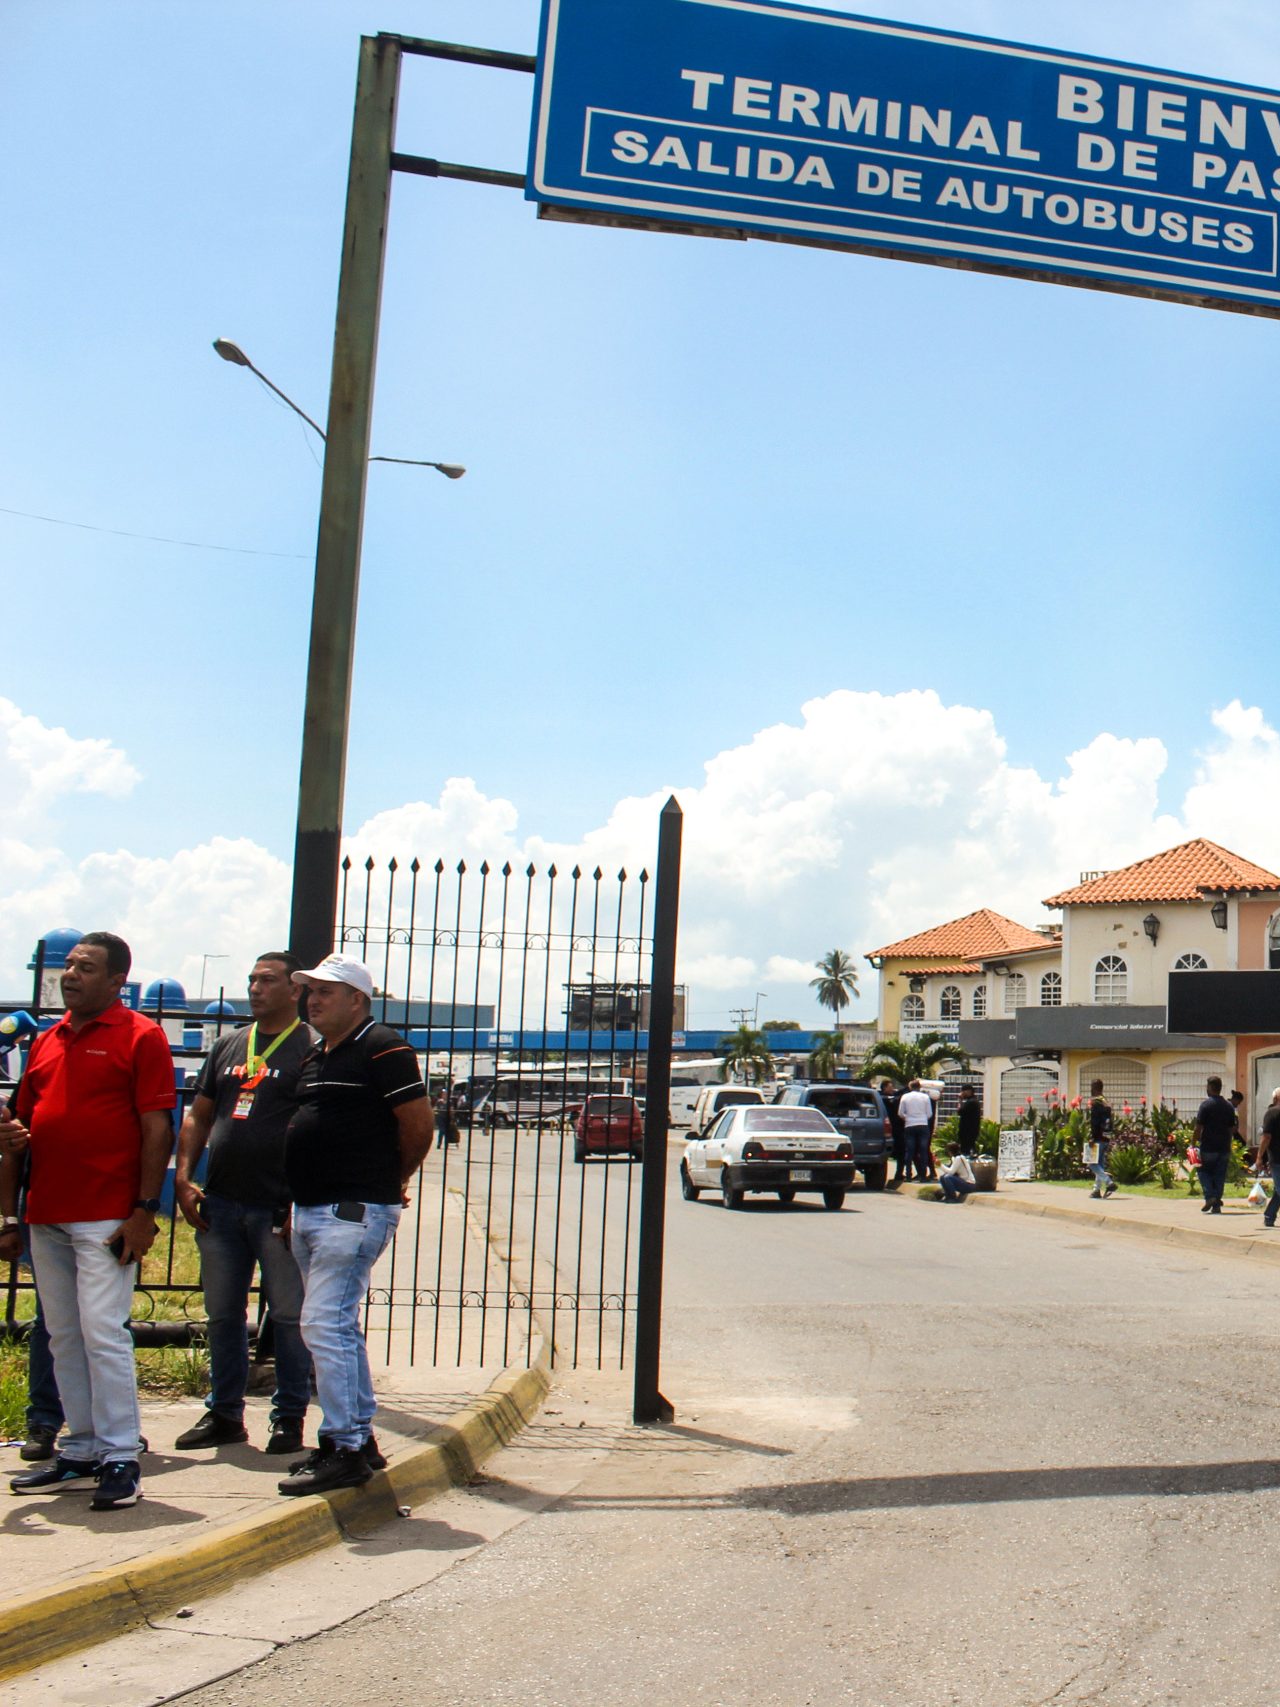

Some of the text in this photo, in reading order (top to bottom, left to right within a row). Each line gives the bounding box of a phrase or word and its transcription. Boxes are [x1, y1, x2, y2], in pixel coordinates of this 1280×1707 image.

[680, 68, 1040, 161] TERMINAL
[1077, 132, 1158, 180] DE
[611, 130, 1254, 253] SALIDA DE AUTOBUSES
